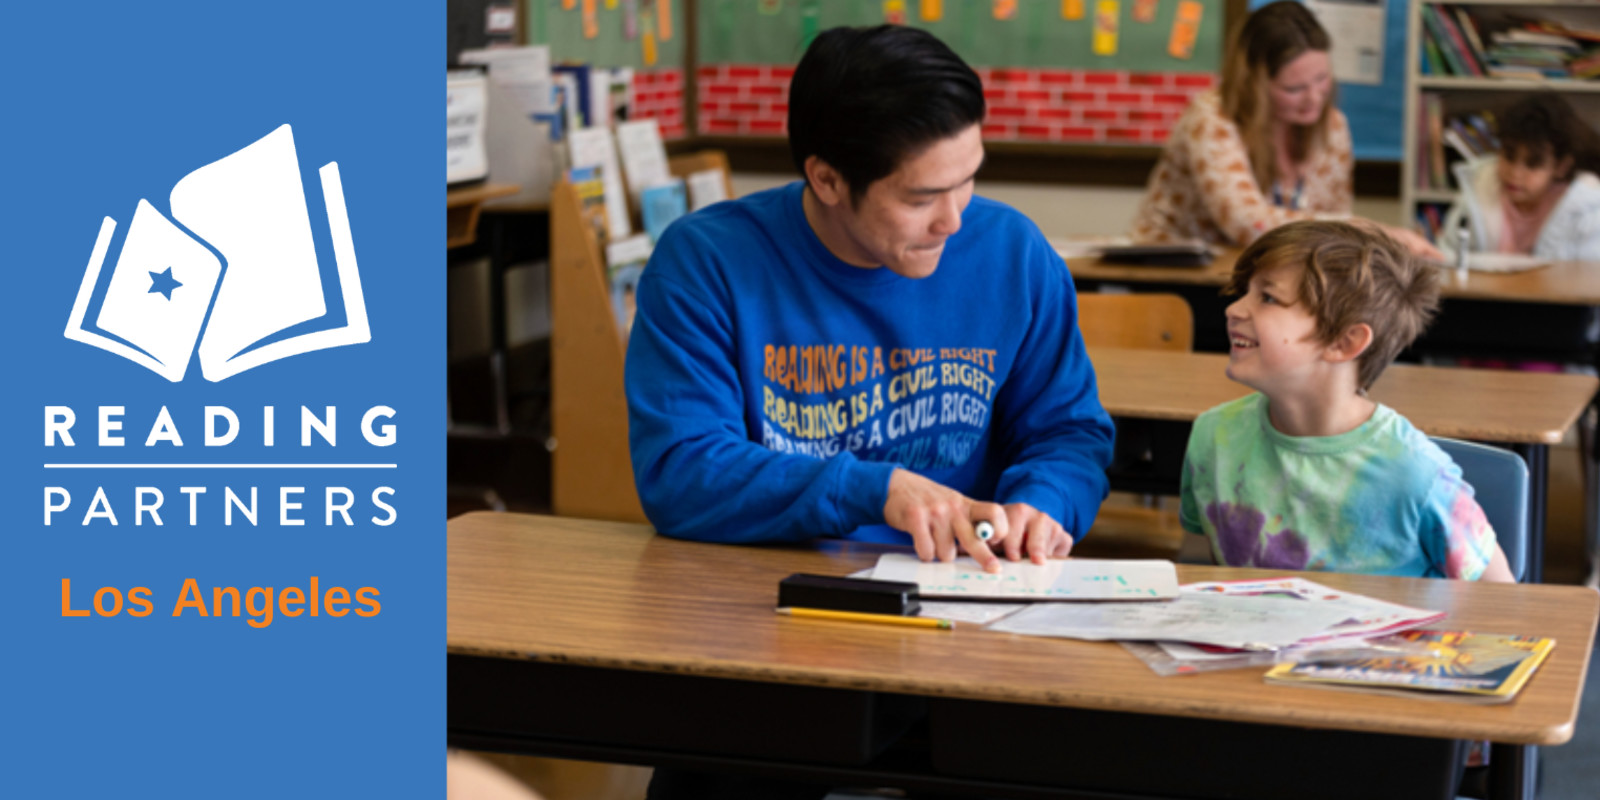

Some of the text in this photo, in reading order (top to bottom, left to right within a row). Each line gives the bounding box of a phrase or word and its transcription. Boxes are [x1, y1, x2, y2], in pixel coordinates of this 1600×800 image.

[851, 344, 868, 386] IS
[871, 345, 885, 379] A
[889, 347, 936, 371] CIVIL
[939, 347, 997, 373] RIGHT
[851, 391, 867, 428] IS
[870, 382, 884, 417] A
[888, 364, 938, 403] CIVIL
[940, 362, 996, 401] RIGHT
[845, 429, 865, 451] IS
[867, 419, 883, 449] A
[886, 394, 938, 440] CIVIL
[940, 391, 989, 428] RIGHT
[933, 430, 980, 470] RIGHT
